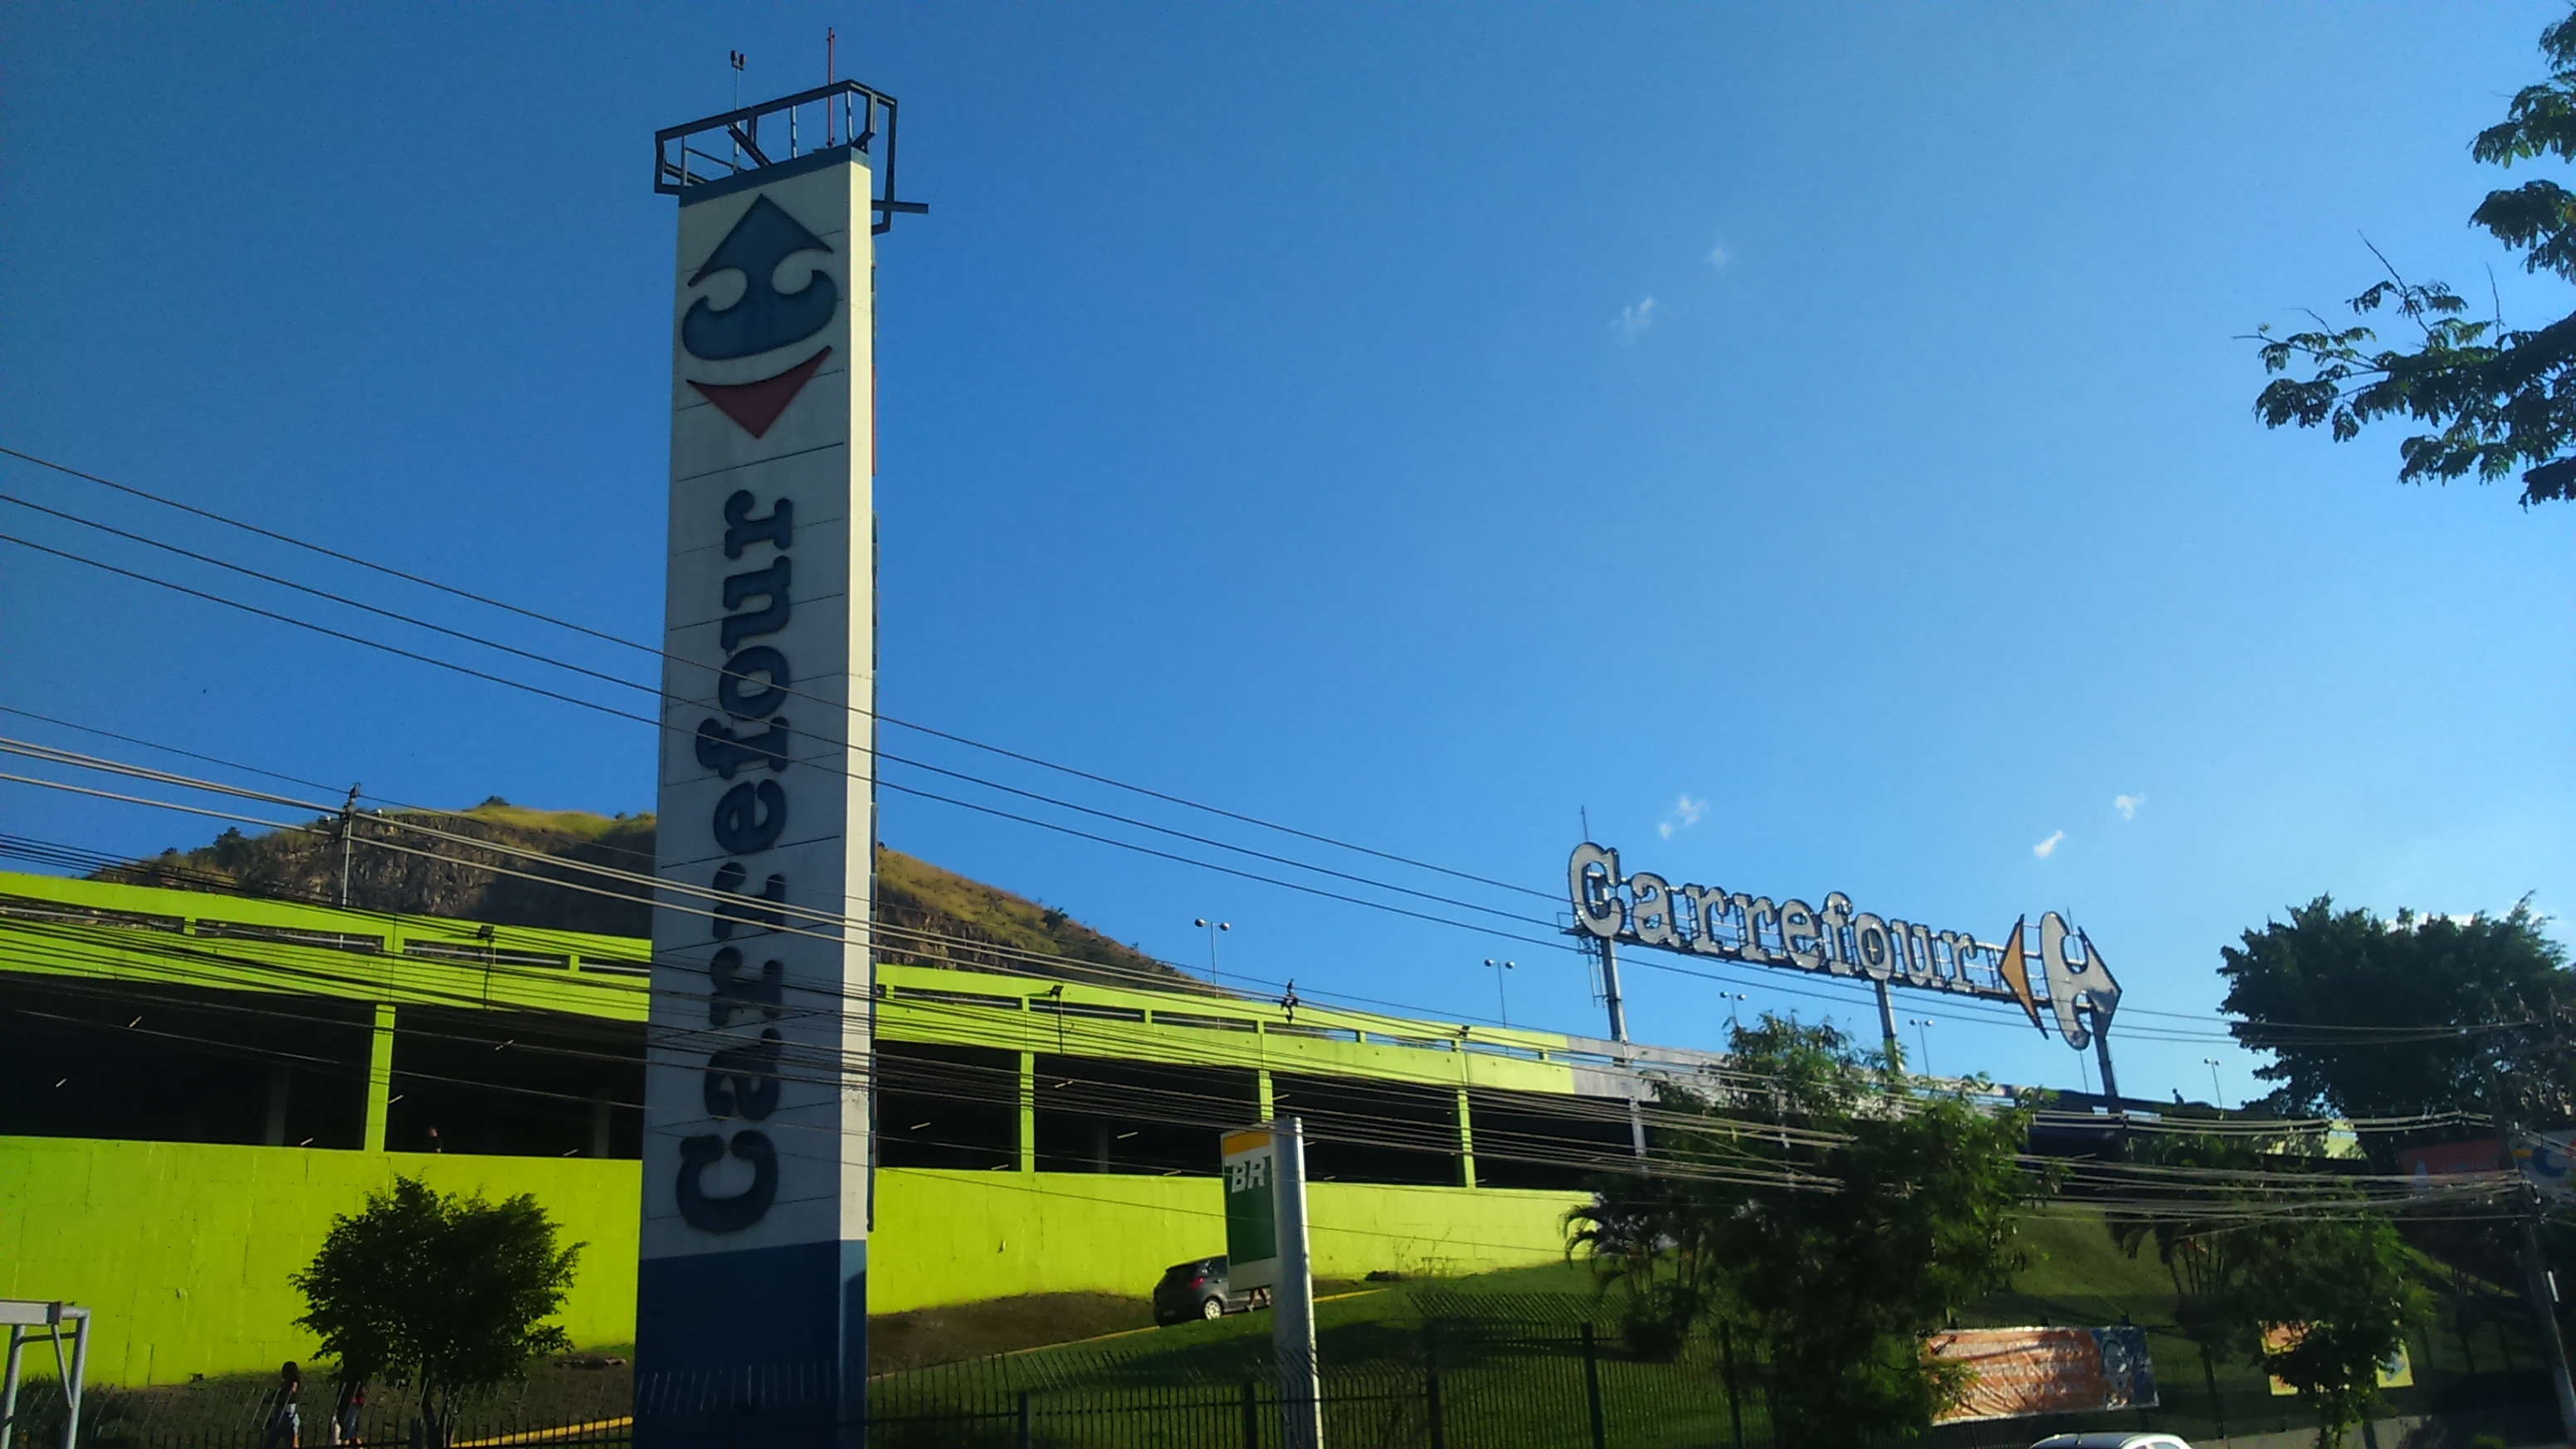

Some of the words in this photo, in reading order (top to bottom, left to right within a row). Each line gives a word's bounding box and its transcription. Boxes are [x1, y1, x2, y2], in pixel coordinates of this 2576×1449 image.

[676, 490, 793, 1234] Carrefour
[1568, 841, 1979, 993] Carrefour
[1229, 1156, 1268, 1193] BR
